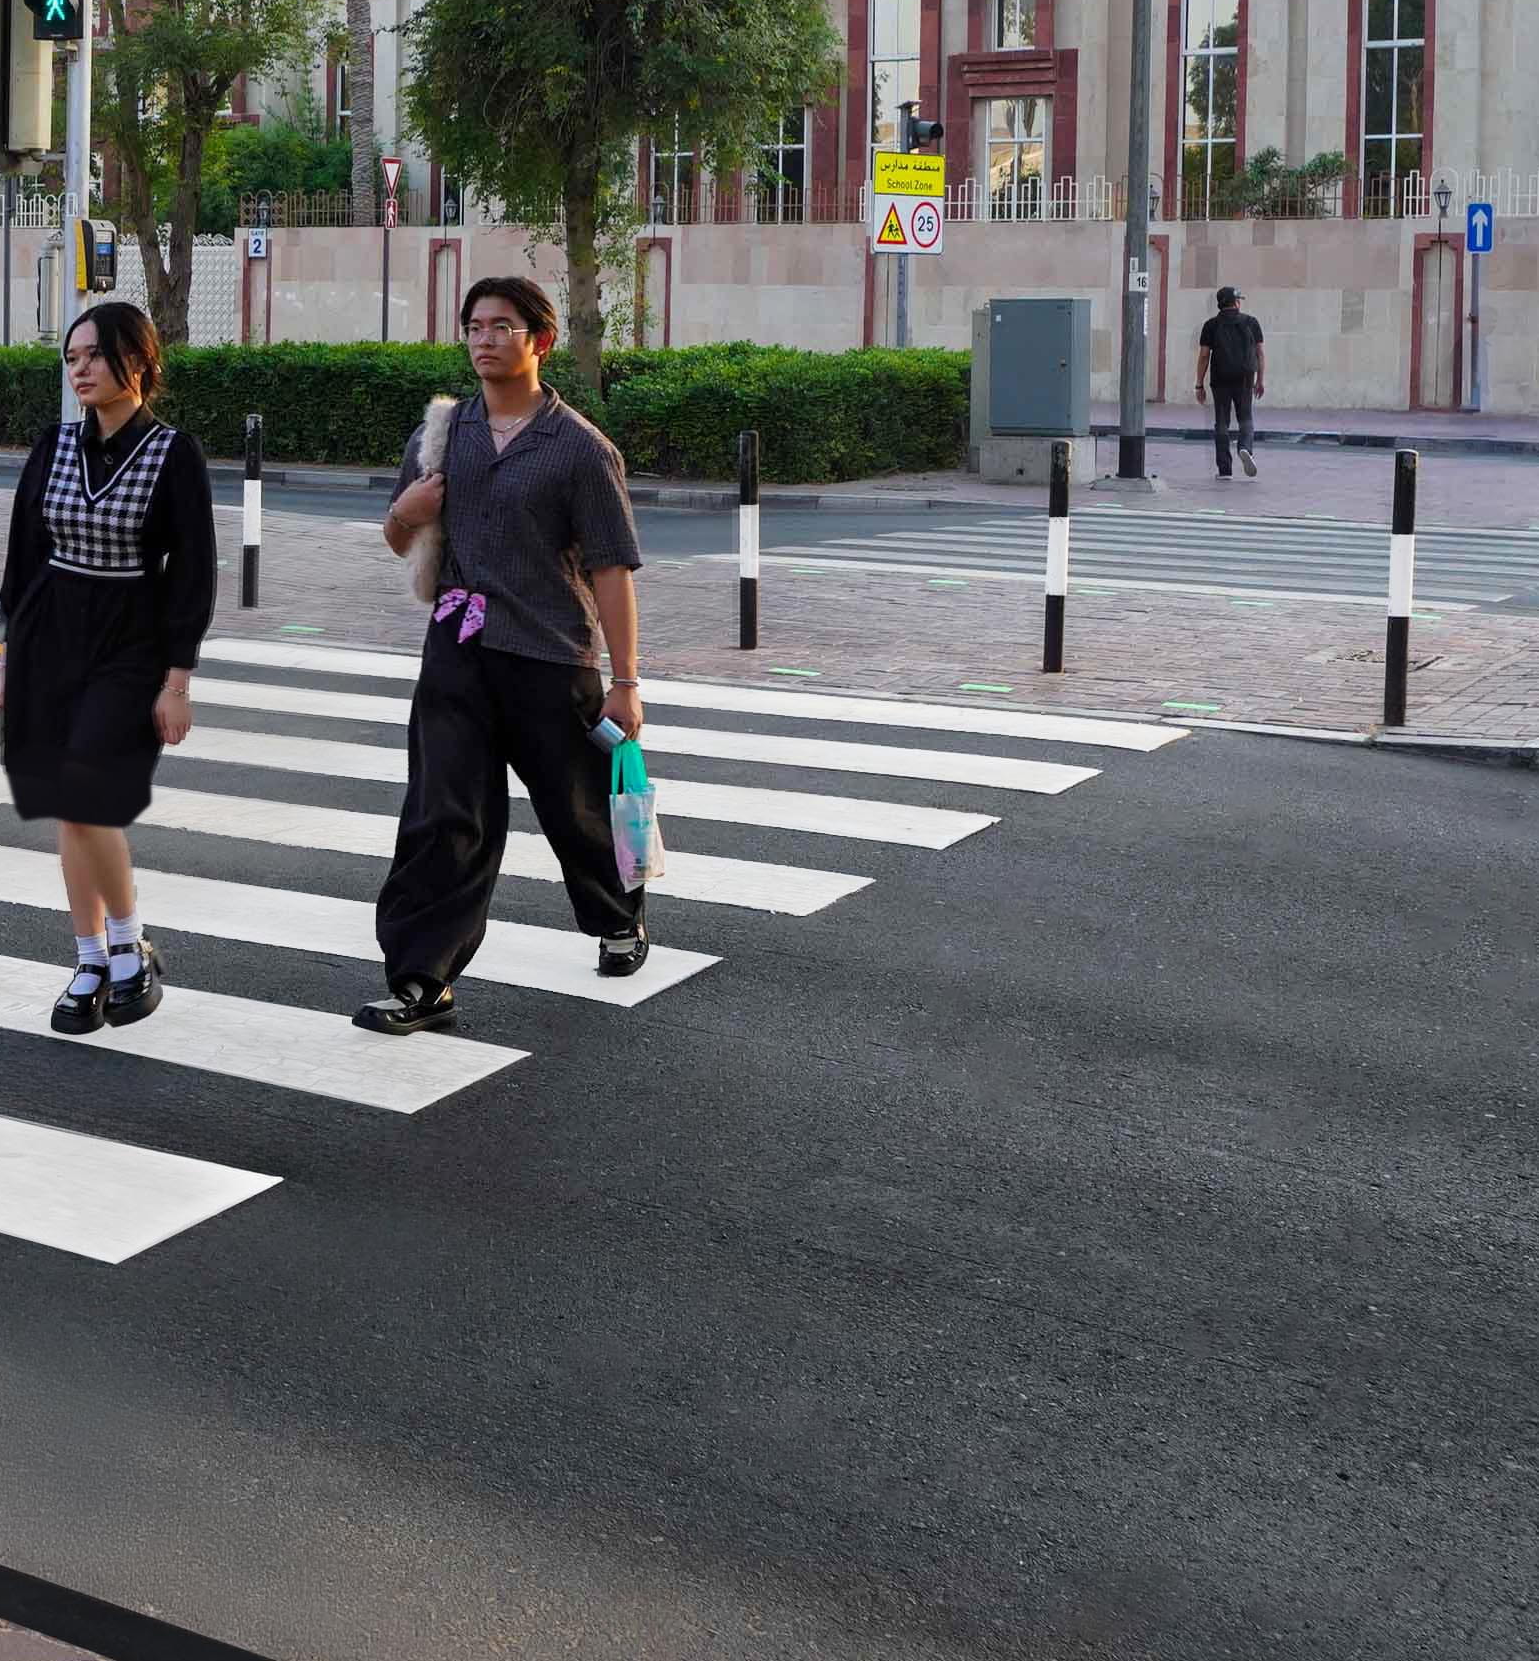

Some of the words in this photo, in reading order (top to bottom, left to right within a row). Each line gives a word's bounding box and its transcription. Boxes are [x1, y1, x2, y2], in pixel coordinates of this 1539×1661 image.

[887, 178, 913, 189] School
[914, 180, 933, 190] Zone
[917, 215, 934, 233] 25
[253, 238, 262, 254] 2
[1137, 276, 1147, 288] 16
